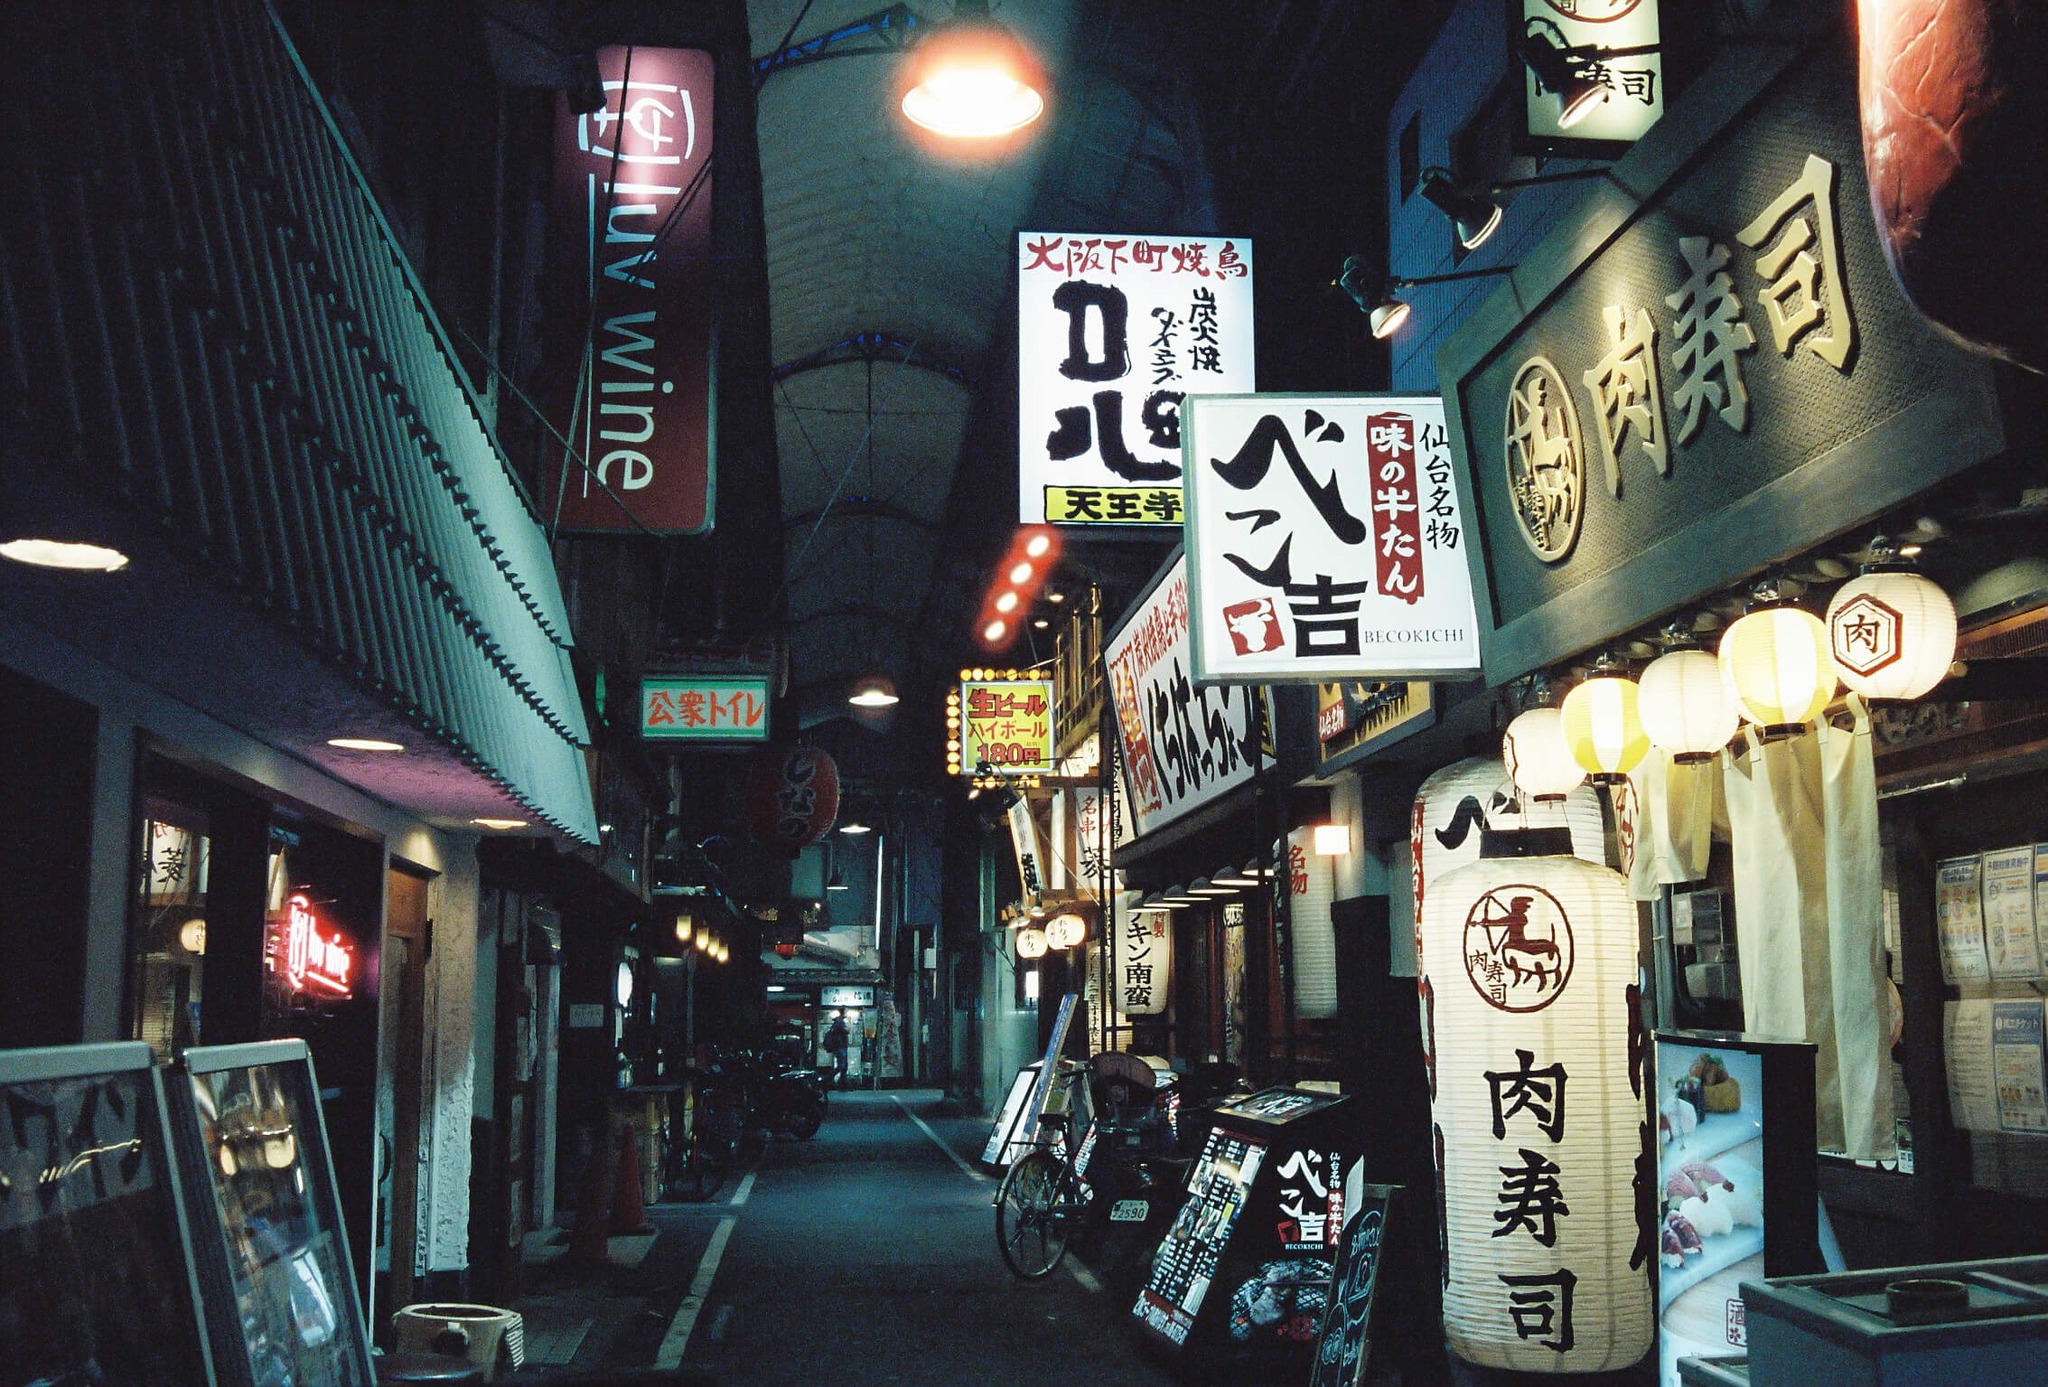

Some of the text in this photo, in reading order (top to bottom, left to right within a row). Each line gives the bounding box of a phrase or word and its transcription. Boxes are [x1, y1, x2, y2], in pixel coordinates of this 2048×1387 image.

[1022, 235, 1249, 280] 大阪下町焼鳥
[598, 181, 681, 491] luv wine
[1583, 153, 1856, 498] 肉寿司
[1065, 490, 1183, 521] 天王寺
[1419, 422, 1460, 550] 仙台名物
[1370, 422, 1418, 594] 味の牛たん
[1364, 628, 1464, 645] BECOKICHI
[1843, 614, 1881, 653] 肉
[648, 690, 764, 727] 公衆トイレ
[967, 688, 1047, 718] 生ビール
[968, 721, 1047, 740] ハイボール
[977, 743, 1041, 766] 180円
[1469, 949, 1508, 1005] 肉寿司
[1483, 1048, 1577, 1353] 肉寿司
